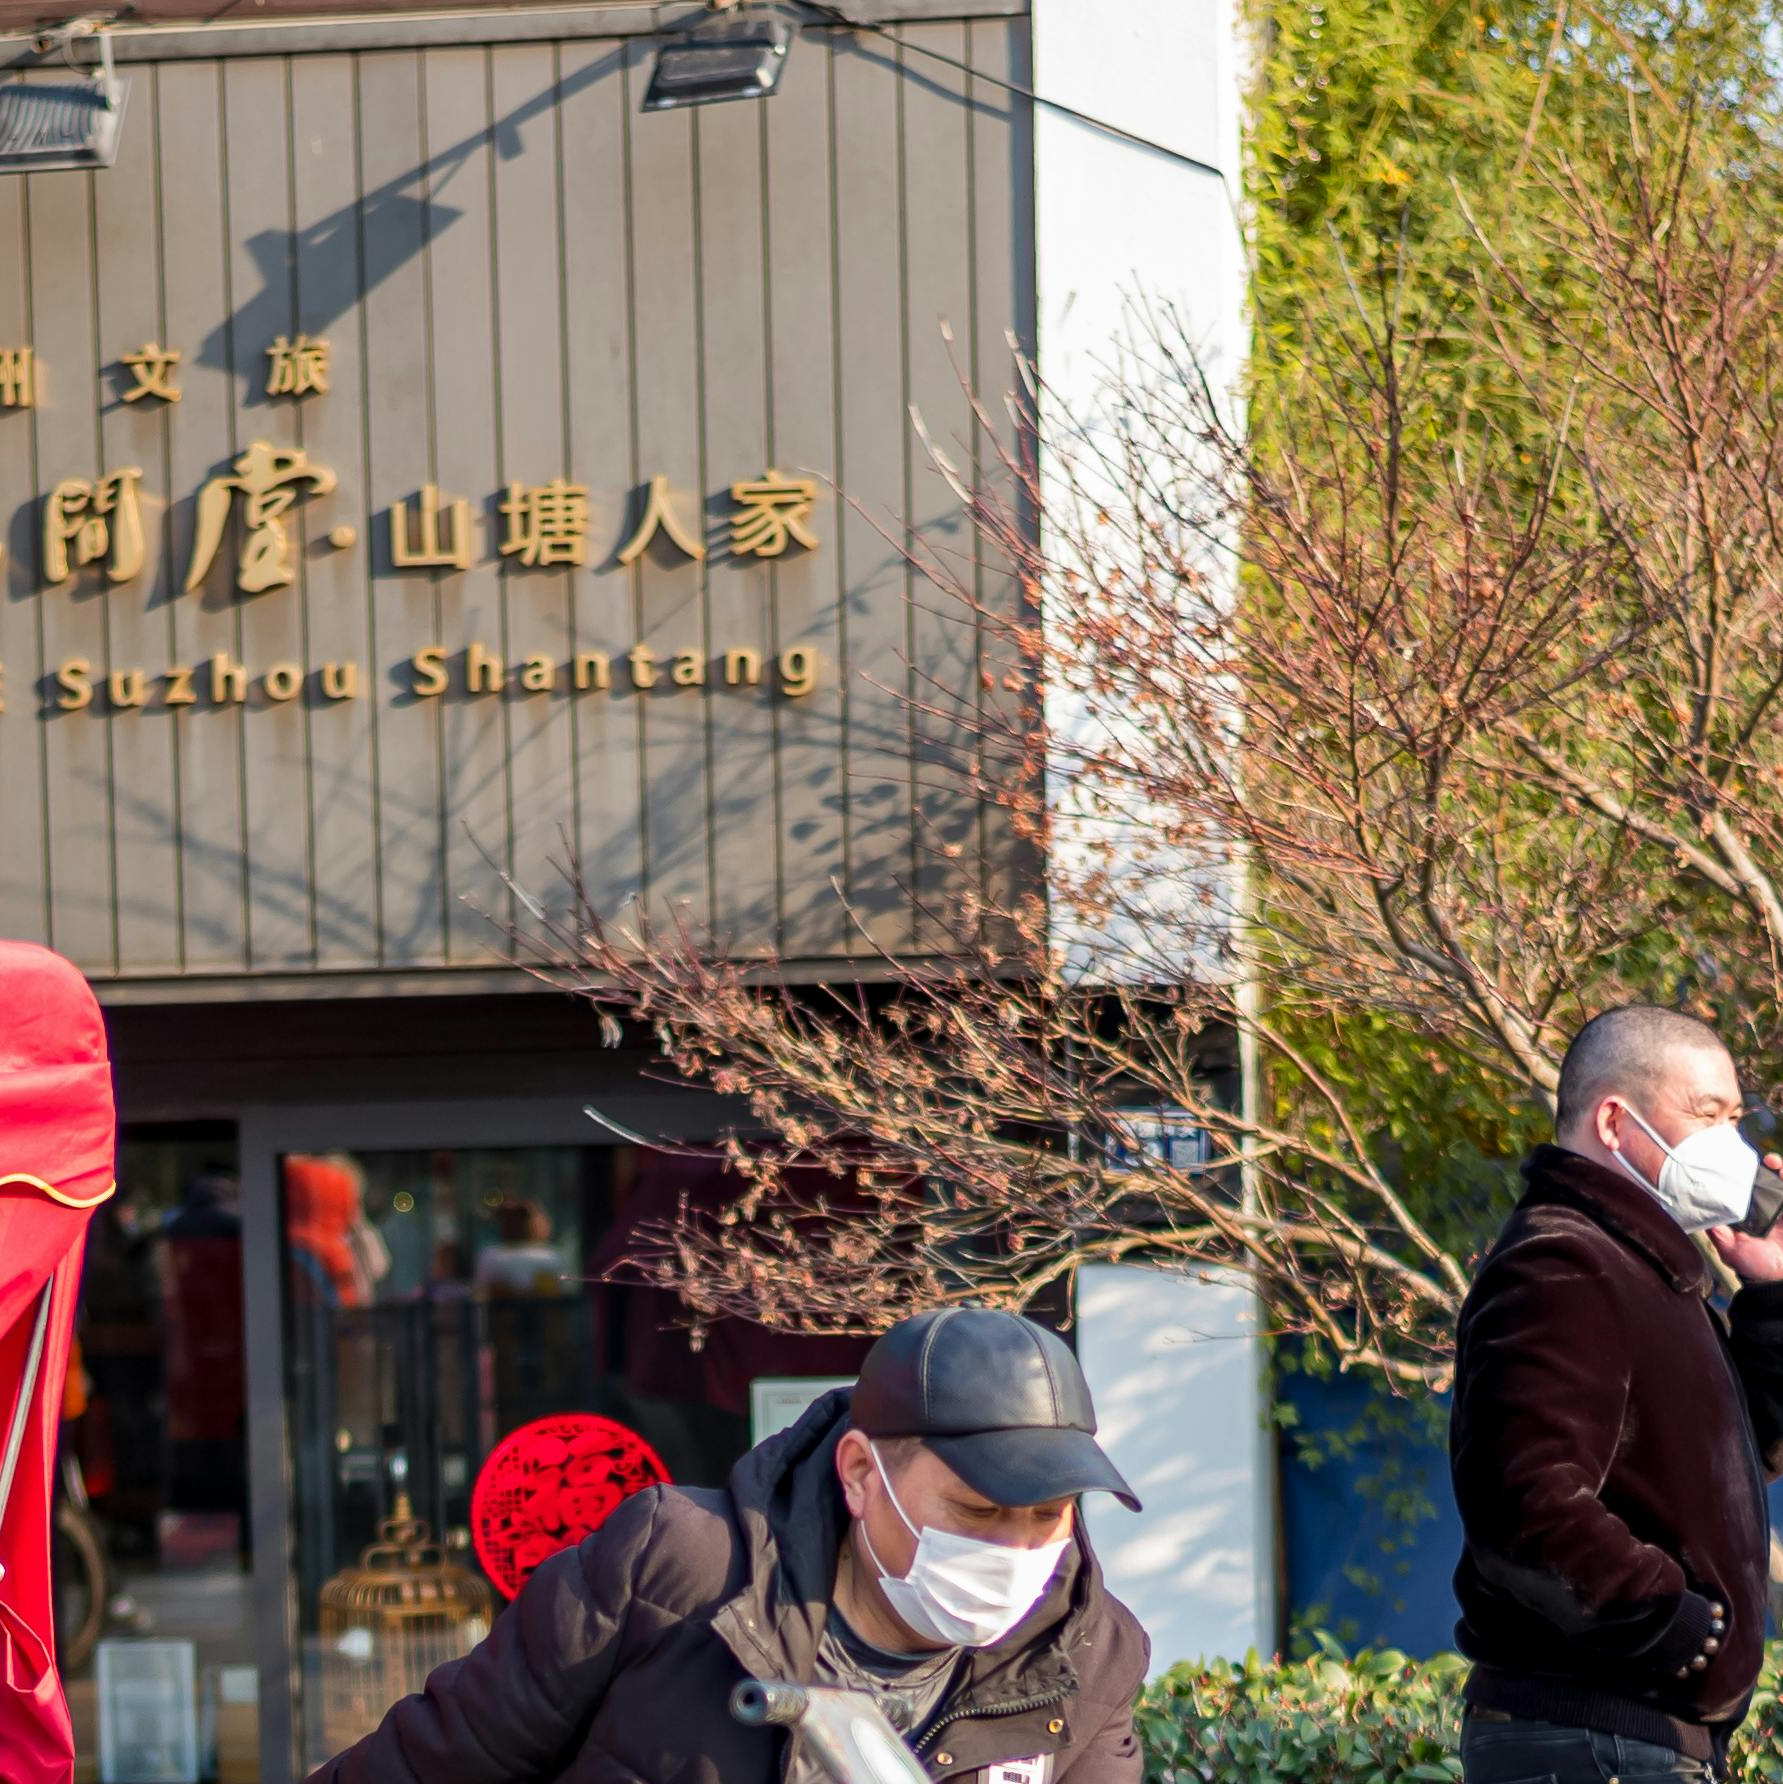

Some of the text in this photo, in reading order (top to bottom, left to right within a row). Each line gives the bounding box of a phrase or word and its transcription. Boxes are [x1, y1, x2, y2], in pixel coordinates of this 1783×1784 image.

[390, 469, 820, 570] 山塘人家
[57, 649, 358, 709] Suzhou
[412, 642, 817, 697] Shantang
